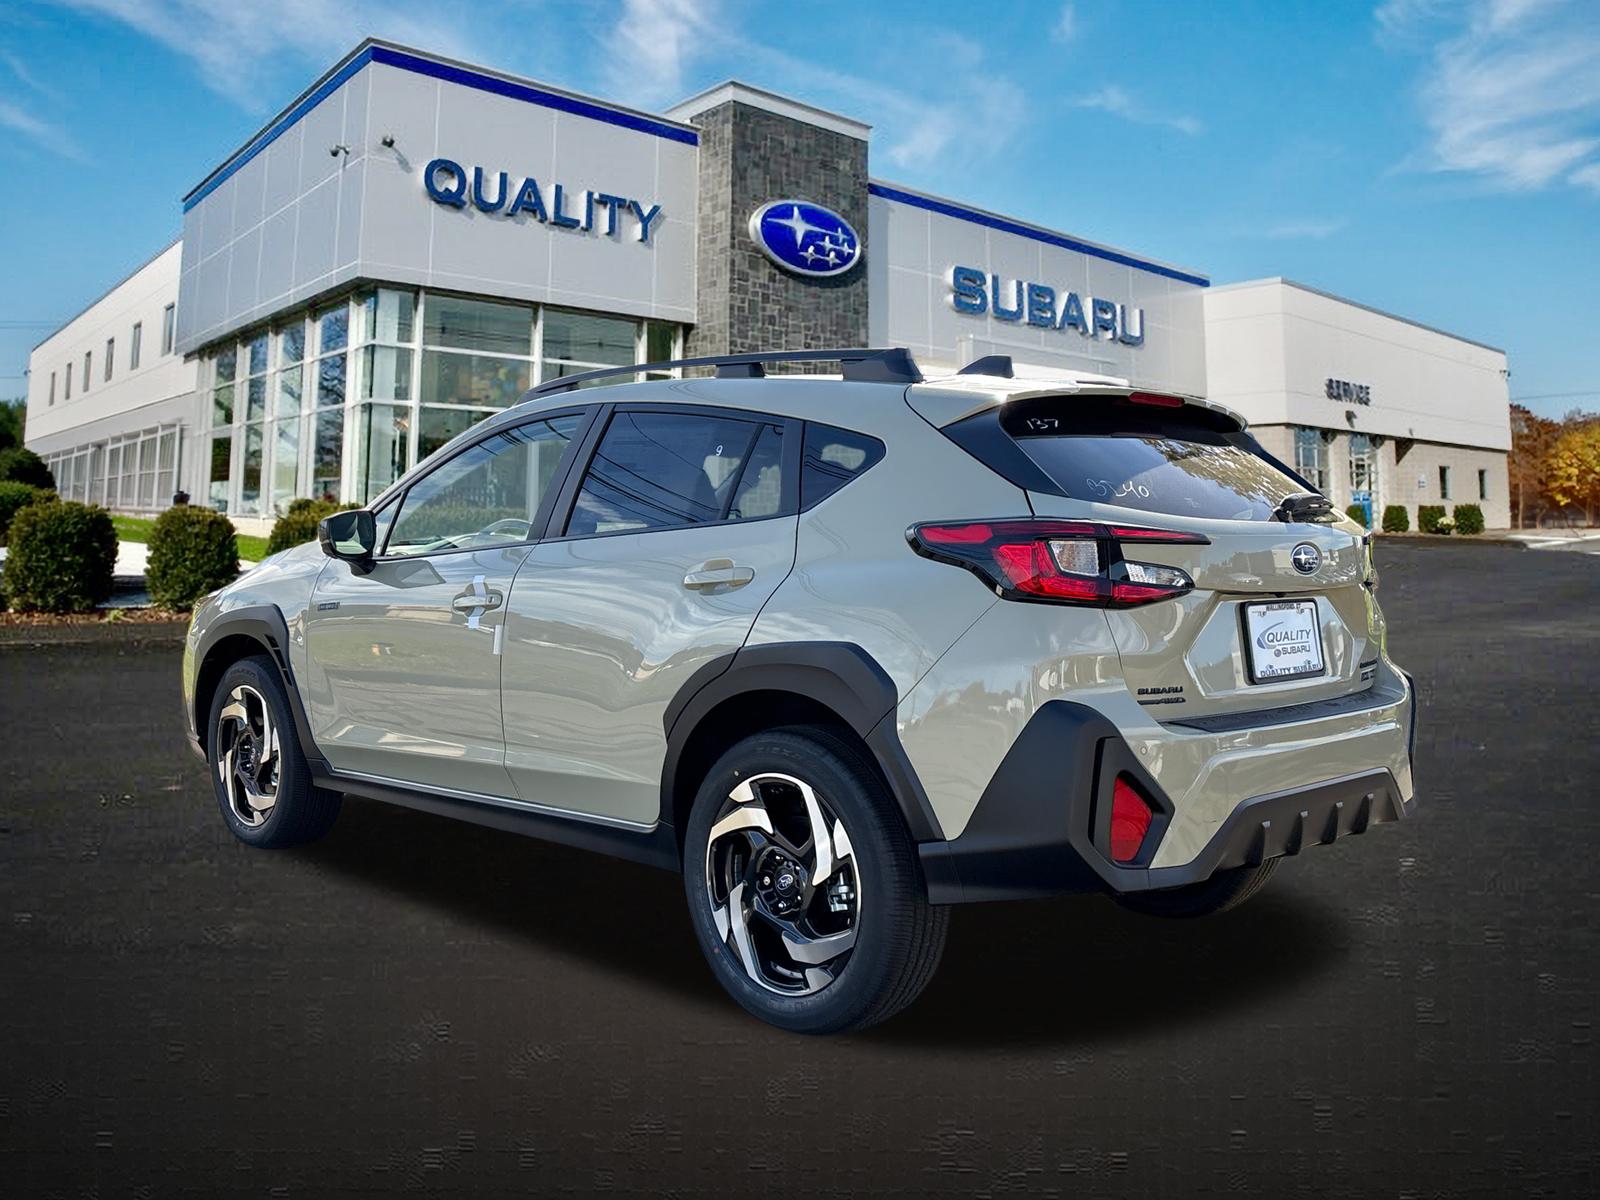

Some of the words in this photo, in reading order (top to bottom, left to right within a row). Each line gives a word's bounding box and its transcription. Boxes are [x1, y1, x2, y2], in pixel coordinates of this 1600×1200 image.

[424, 158, 662, 243] QUALITY
[950, 265, 1145, 347] SUBARU
[1266, 628, 1312, 644] QUALITY
[1281, 644, 1311, 656] SUBARU
[1137, 686, 1184, 695] SUBARU
